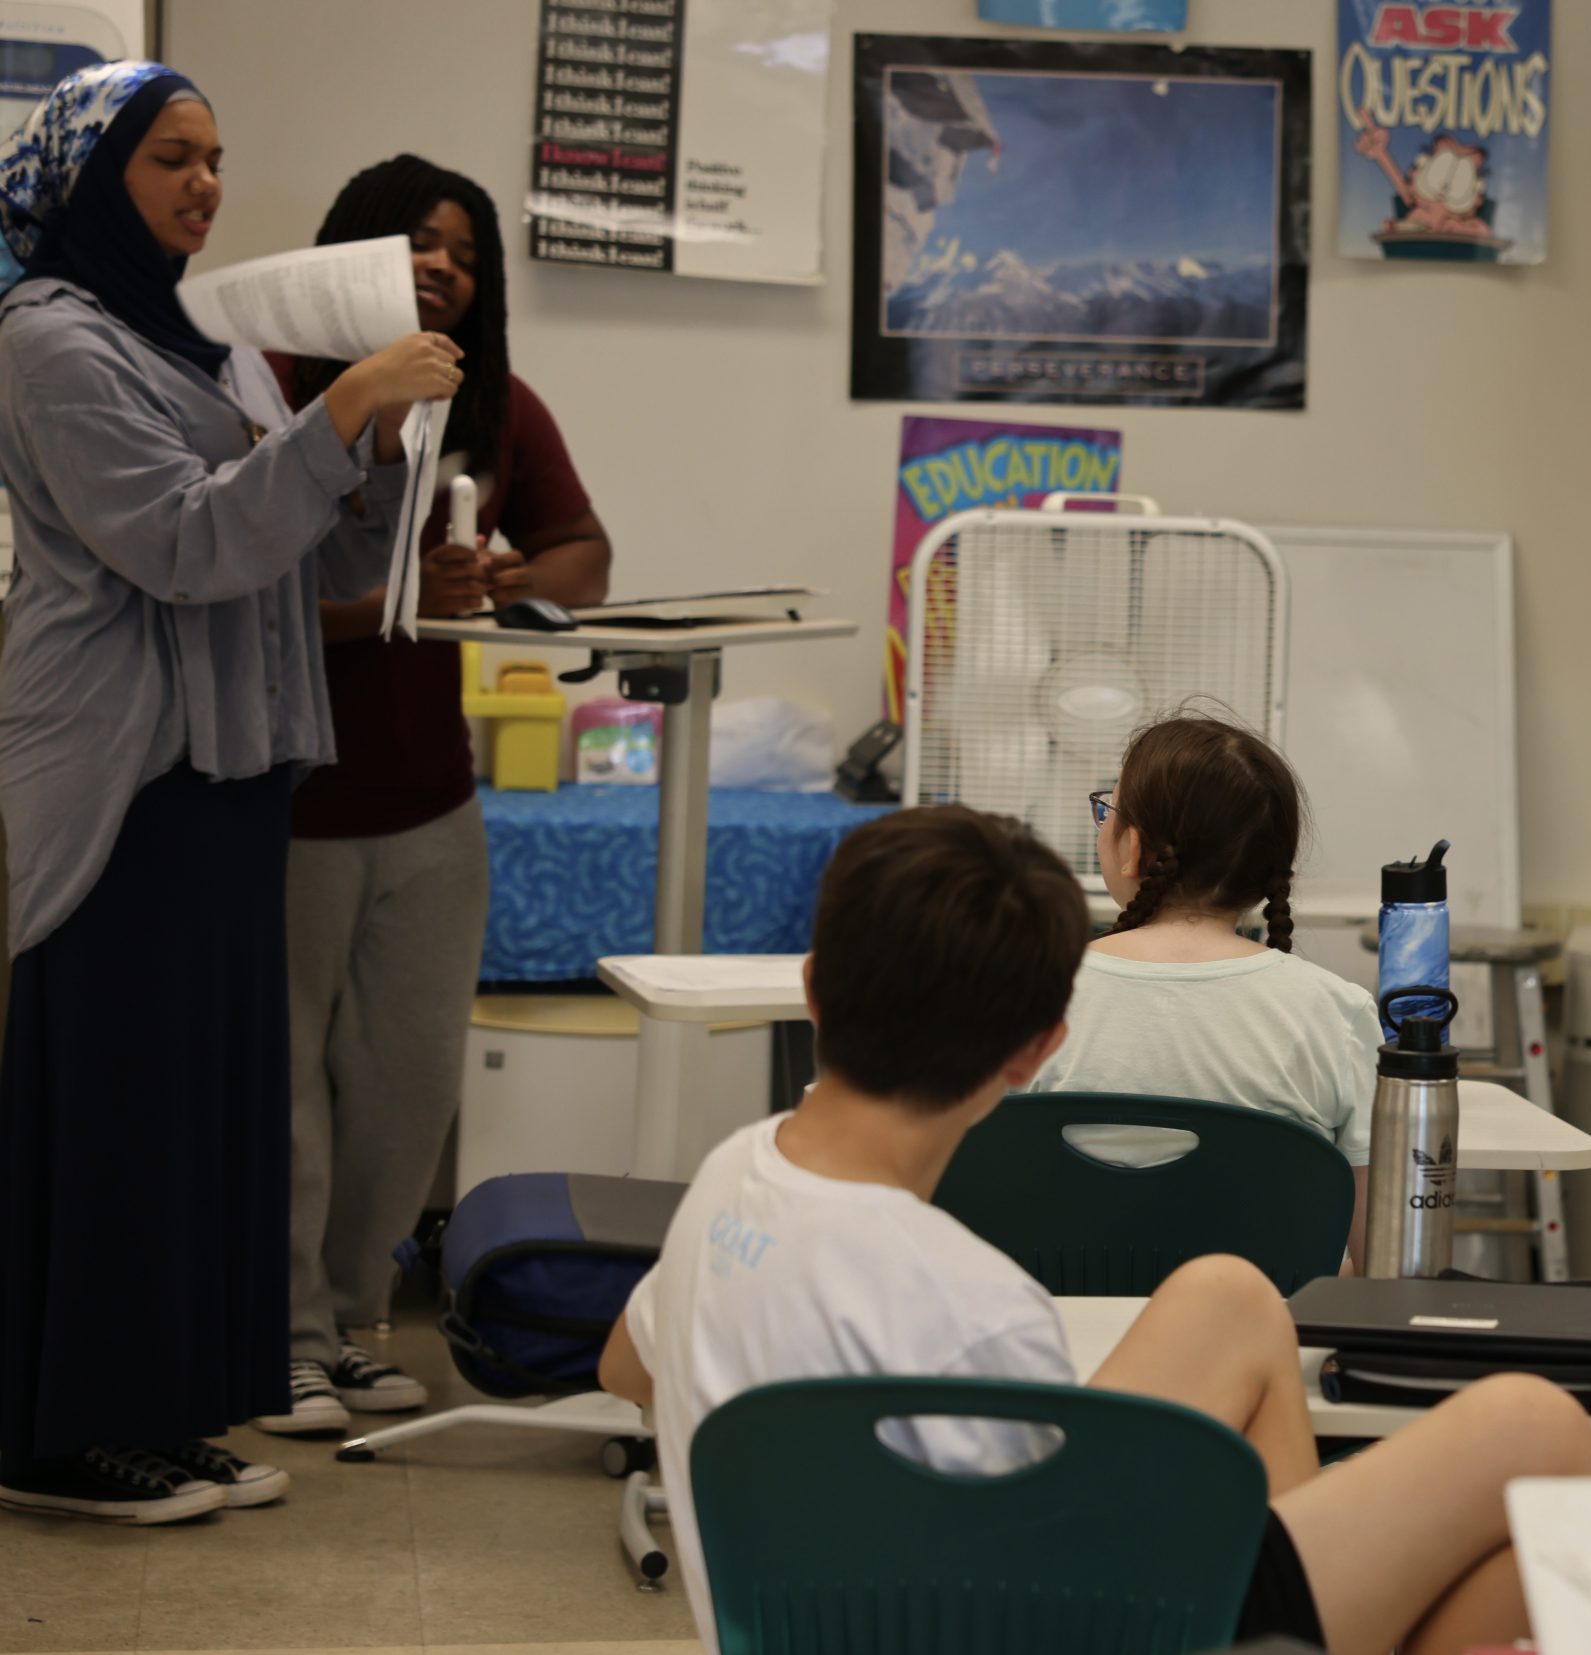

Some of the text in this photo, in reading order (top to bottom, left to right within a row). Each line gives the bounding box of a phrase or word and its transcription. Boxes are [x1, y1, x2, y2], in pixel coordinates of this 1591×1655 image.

[1369, 5, 1518, 52] ASK
[1341, 41, 1547, 138] QUESTIONS
[971, 360, 1189, 382] PERSEVERANCE
[902, 441, 1118, 518] EDUCATION
